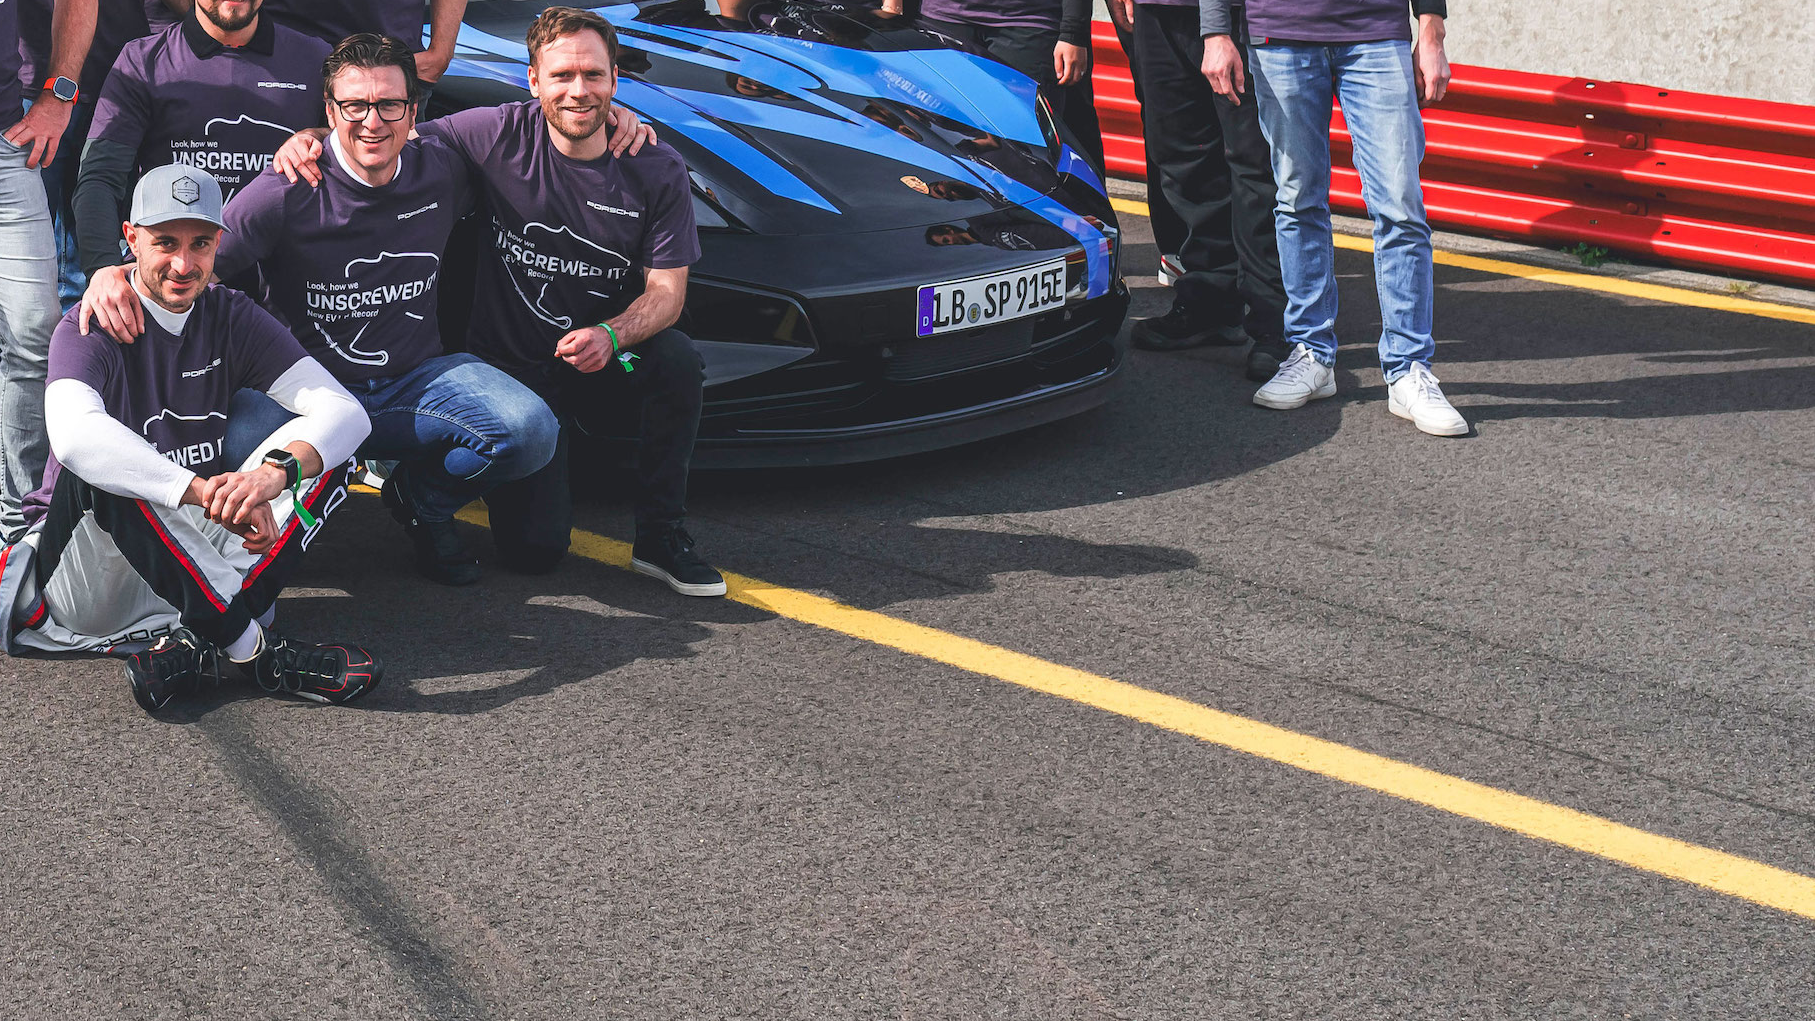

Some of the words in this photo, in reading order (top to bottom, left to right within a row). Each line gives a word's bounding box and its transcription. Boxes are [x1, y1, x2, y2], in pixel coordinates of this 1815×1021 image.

[257, 81, 307, 90] PORSCHE
[172, 151, 274, 171] UNSCREWE
[586, 200, 639, 218] PORSCHE
[507, 230, 523, 244] how
[524, 240, 535, 249] we
[307, 281, 328, 291] Look,
[329, 282, 347, 291] how
[306, 280, 424, 310] UNSCREWED
[933, 290, 966, 327] LB
[984, 280, 1011, 318] SP
[1017, 267, 1063, 312] 915E
[307, 309, 324, 319] New
[325, 313, 336, 322] EV
[351, 309, 379, 318] Record
[922, 316, 929, 327] D
